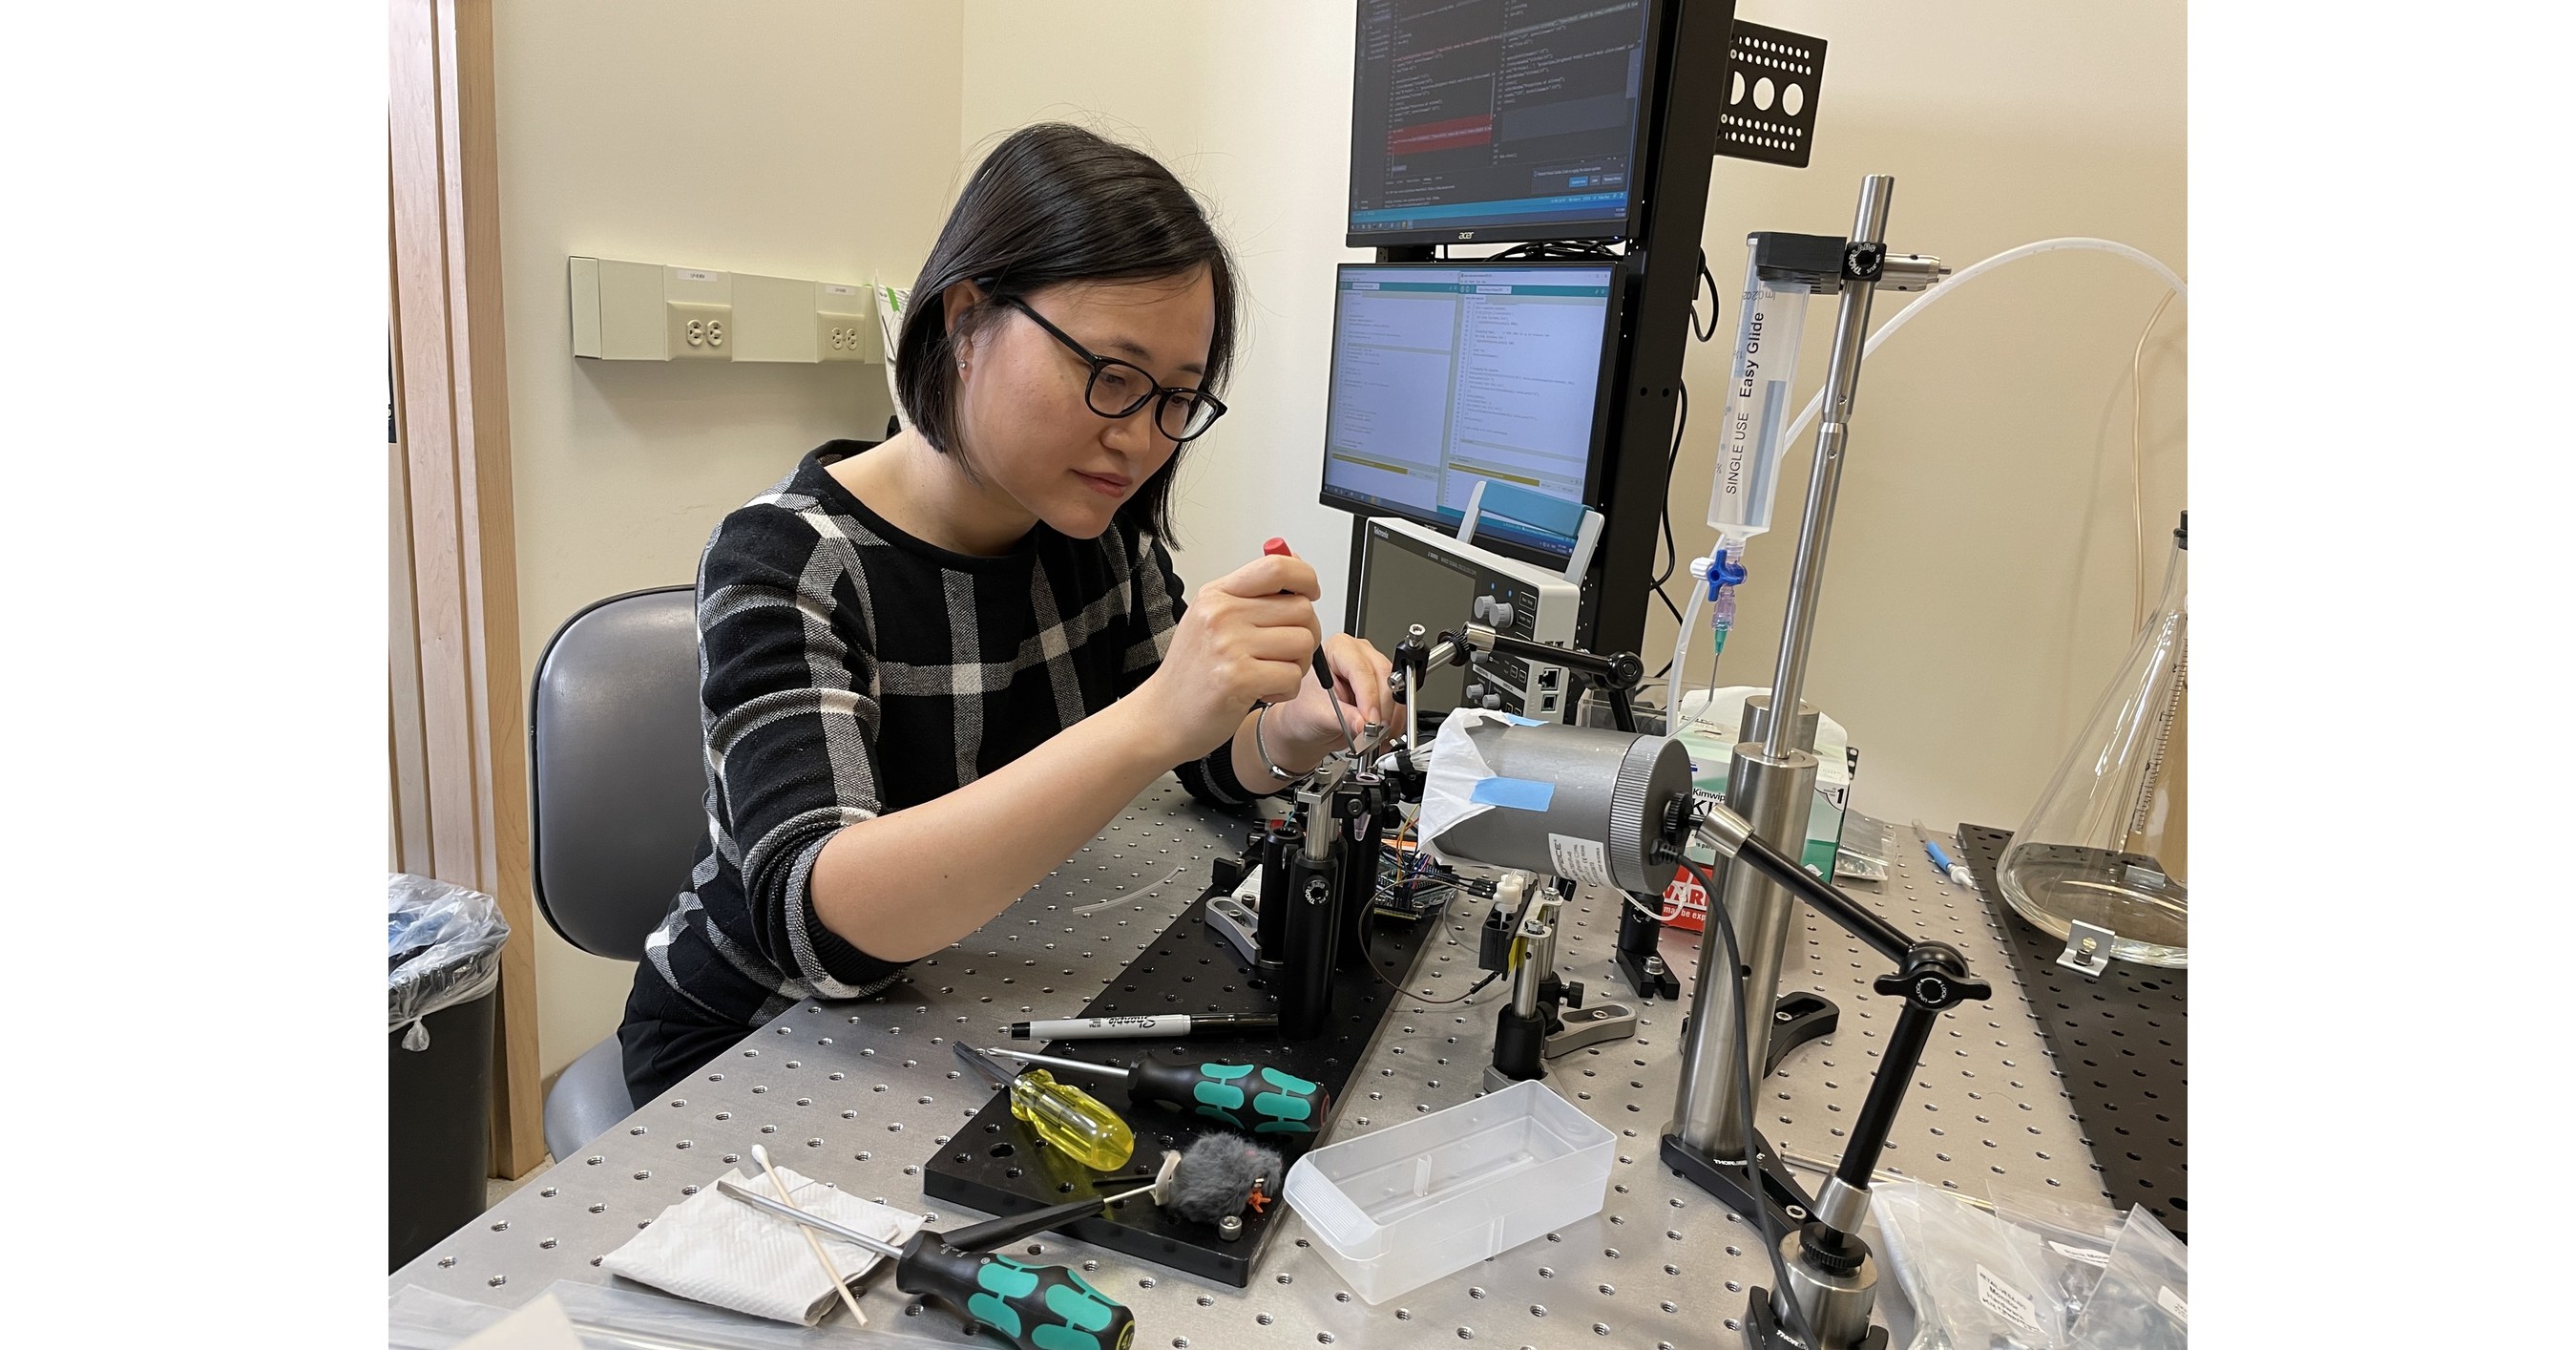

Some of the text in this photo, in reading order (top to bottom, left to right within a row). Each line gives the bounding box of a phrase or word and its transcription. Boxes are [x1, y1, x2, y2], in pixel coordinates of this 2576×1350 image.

[1849, 243, 1876, 275] THORLABS
[1739, 312, 1764, 398] Easy Glide
[1726, 412, 1749, 495] SINGLE USE
[1837, 788, 1845, 804] 1
[1681, 909, 1691, 918] be
[1916, 982, 1928, 1002] UNLOCK
